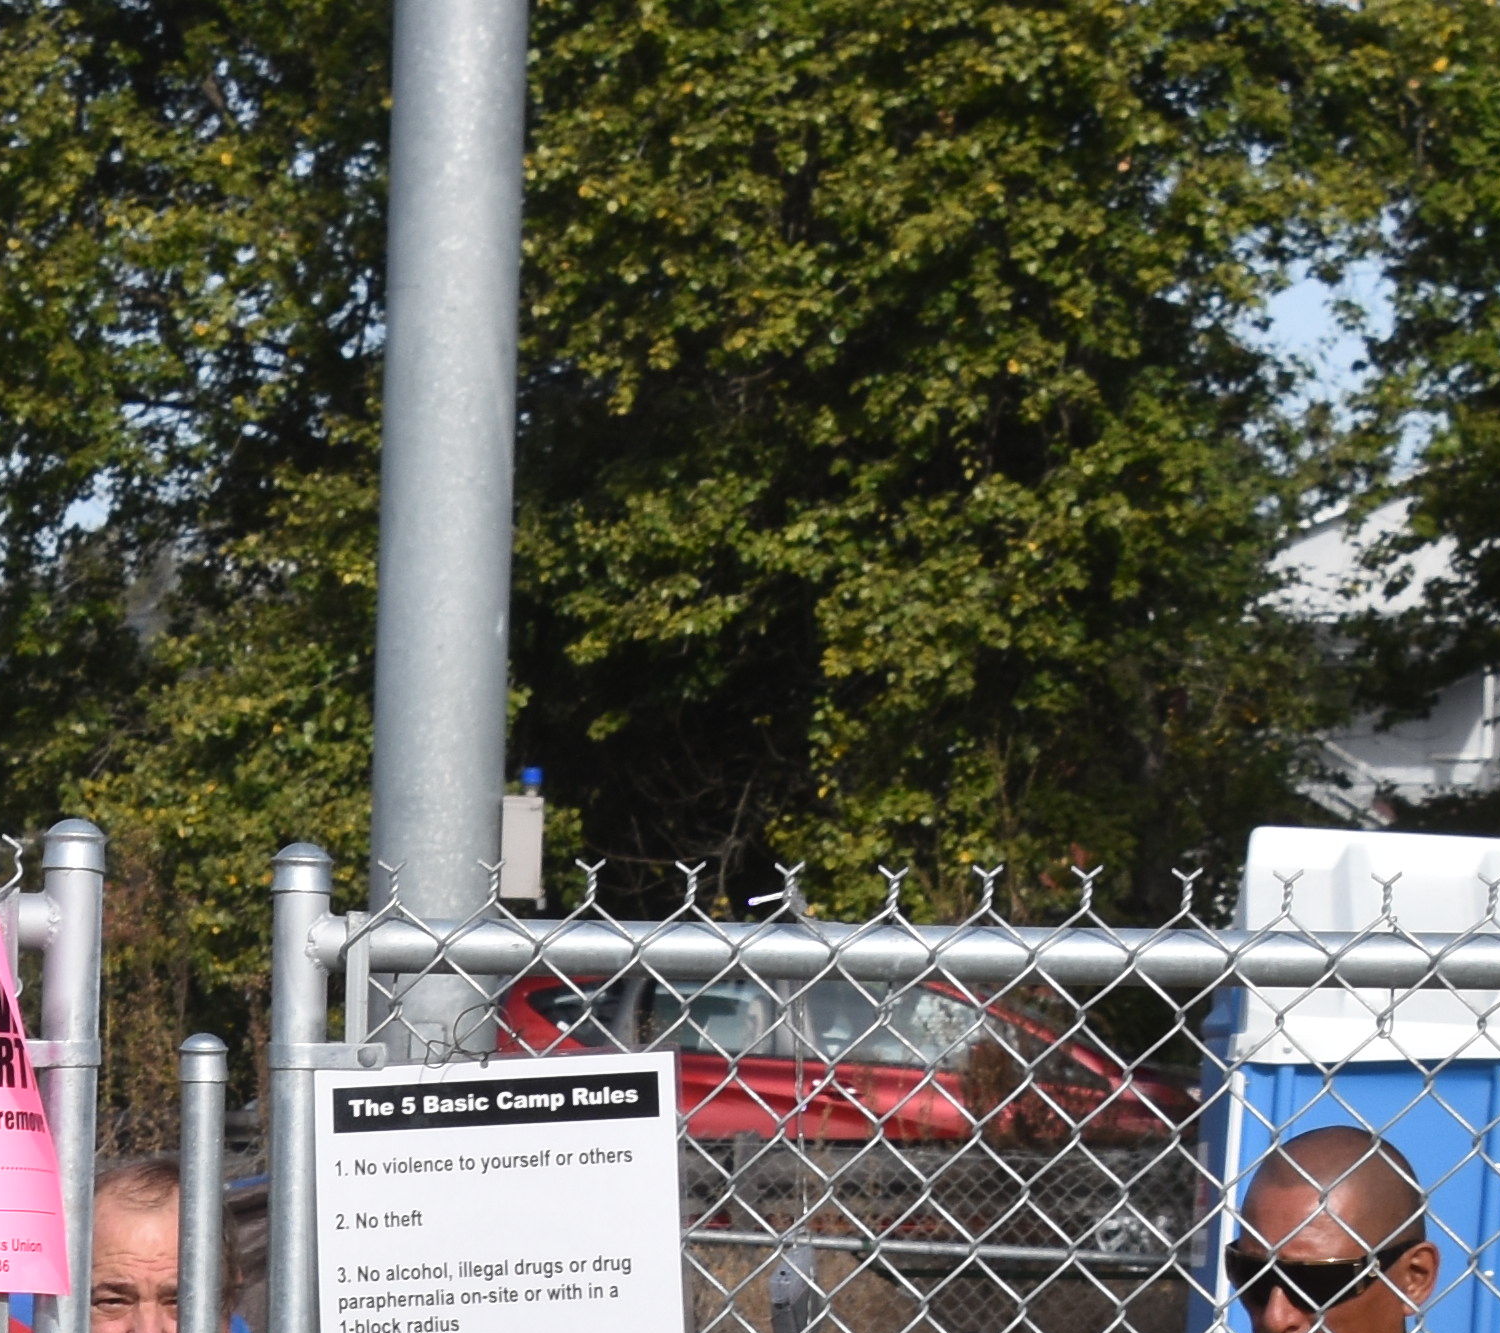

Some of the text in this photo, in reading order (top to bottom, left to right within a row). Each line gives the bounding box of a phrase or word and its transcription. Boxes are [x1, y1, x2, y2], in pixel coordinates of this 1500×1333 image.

[347, 1086, 639, 1118] The 5 Basic Camp Rules
[334, 1147, 633, 1177] 1. No violence to yourself or others
[335, 1209, 423, 1230] 2. No theft
[11, 1237, 43, 1253] Union
[337, 1255, 632, 1284] 3. No alcohol, illegal drugs or drug
[338, 1282, 619, 1315] paraphernalia on-site or with in a
[406, 1315, 460, 1333] radius
